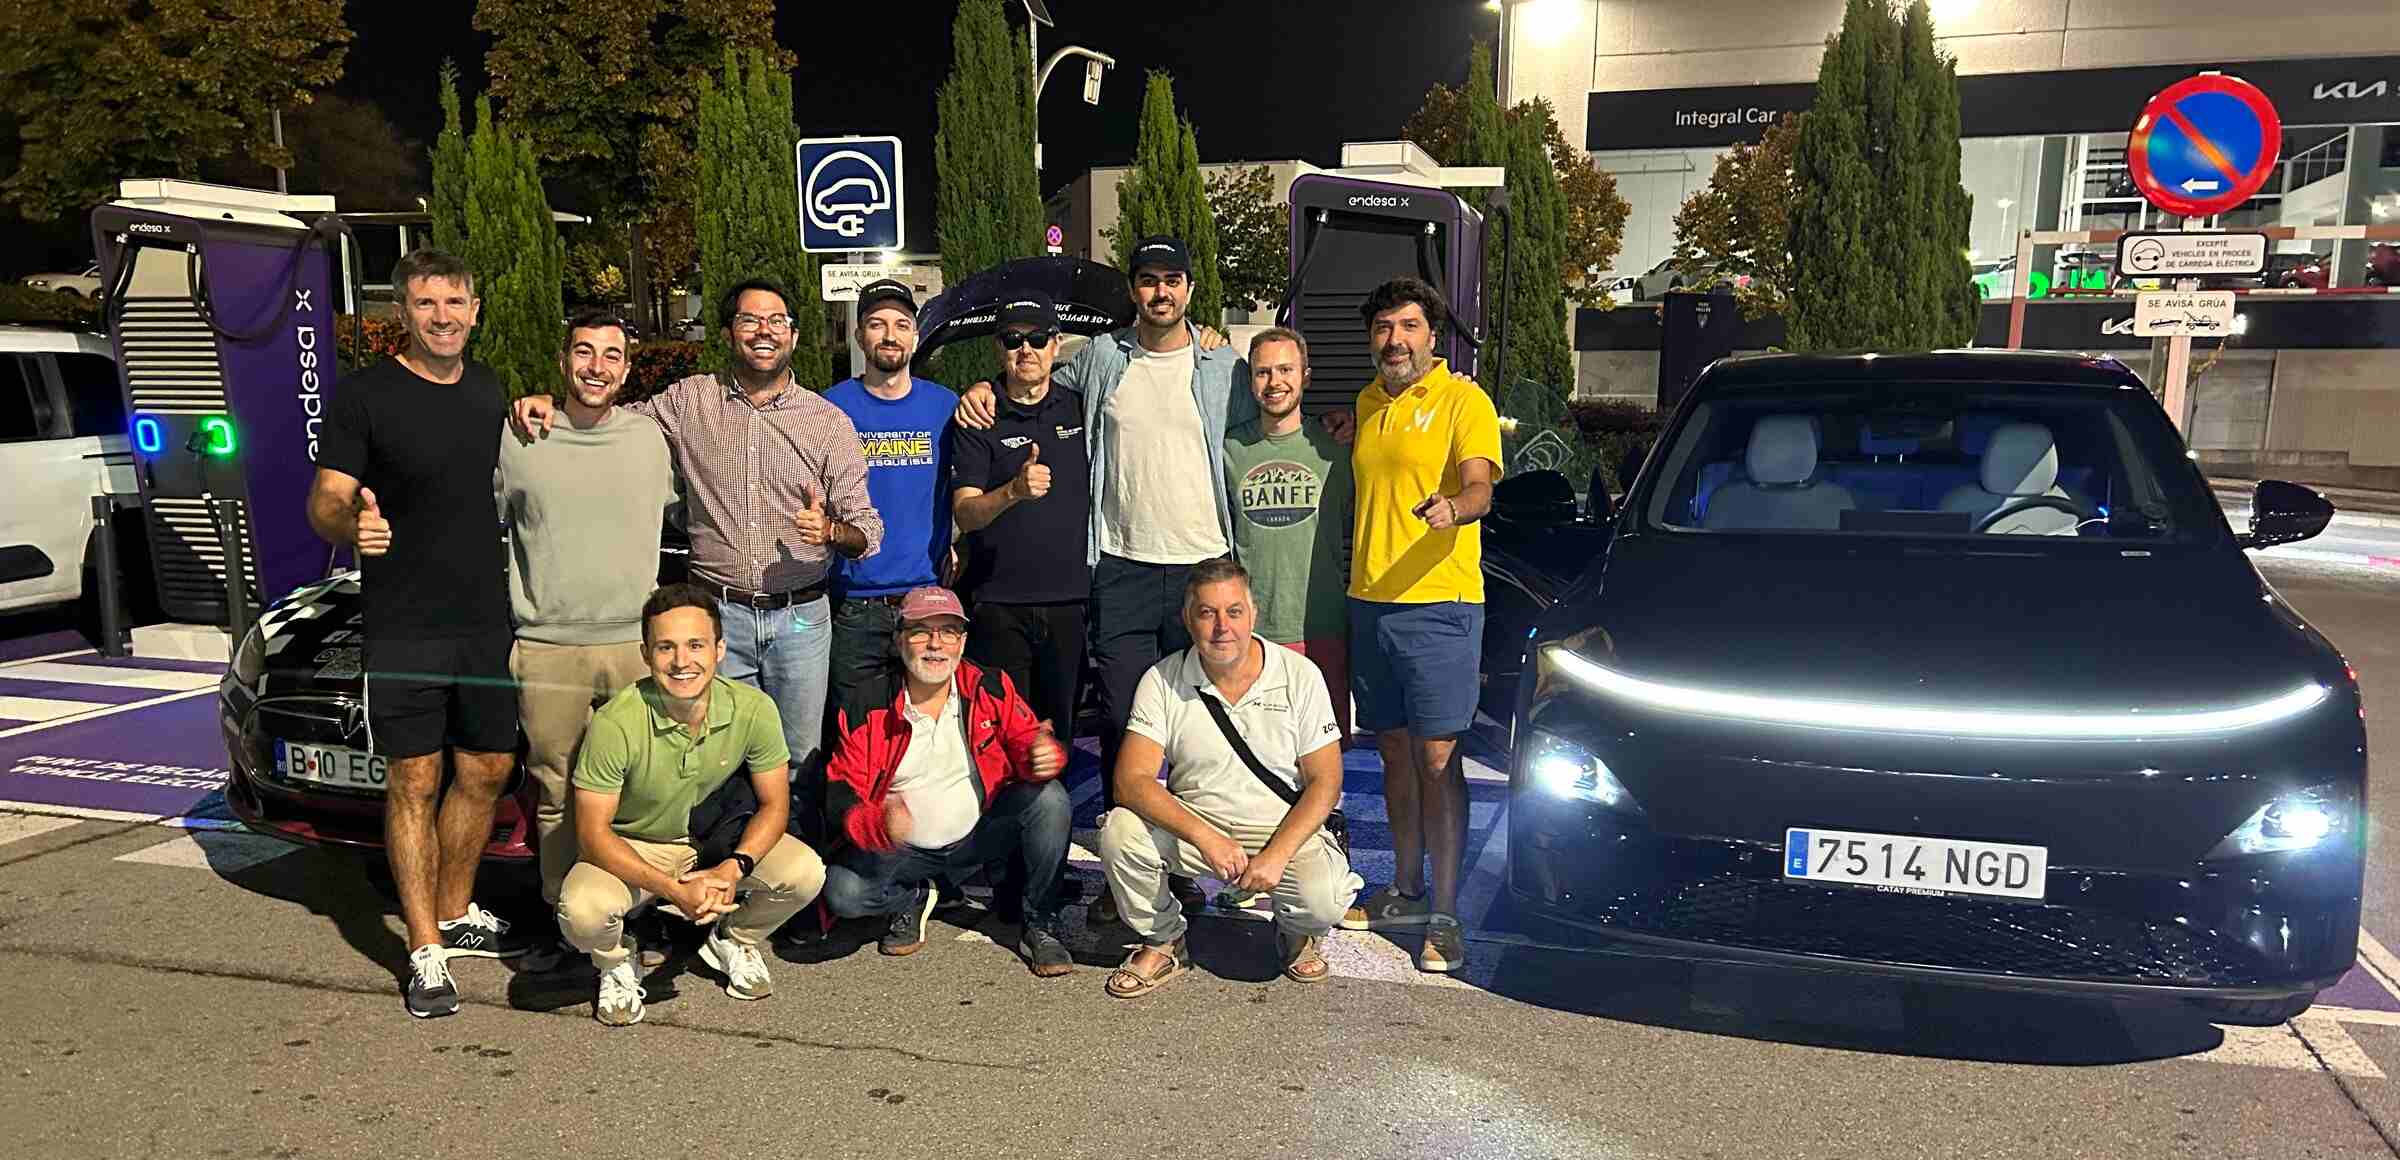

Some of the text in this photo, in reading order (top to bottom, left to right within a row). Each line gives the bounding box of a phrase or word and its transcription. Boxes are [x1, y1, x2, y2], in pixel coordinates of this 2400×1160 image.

[1675, 107, 1777, 128] Integral Car
[1348, 195, 1397, 207] endesa
[130, 223, 162, 233] endesa
[2147, 299, 2161, 308] SE
[2165, 299, 2194, 308] AVISA
[297, 326, 324, 463] endesa
[855, 431, 915, 439] NIVERSITY
[865, 458, 909, 467] ESQUE
[1242, 486, 1316, 507] BANFF
[17, 755, 102, 767] PUNT
[291, 746, 387, 785] B 10 EG
[1793, 858, 1802, 868] E
[1816, 838, 2031, 890] 7514 NGD
[1876, 885, 1945, 897] CATAY PREMIUM
